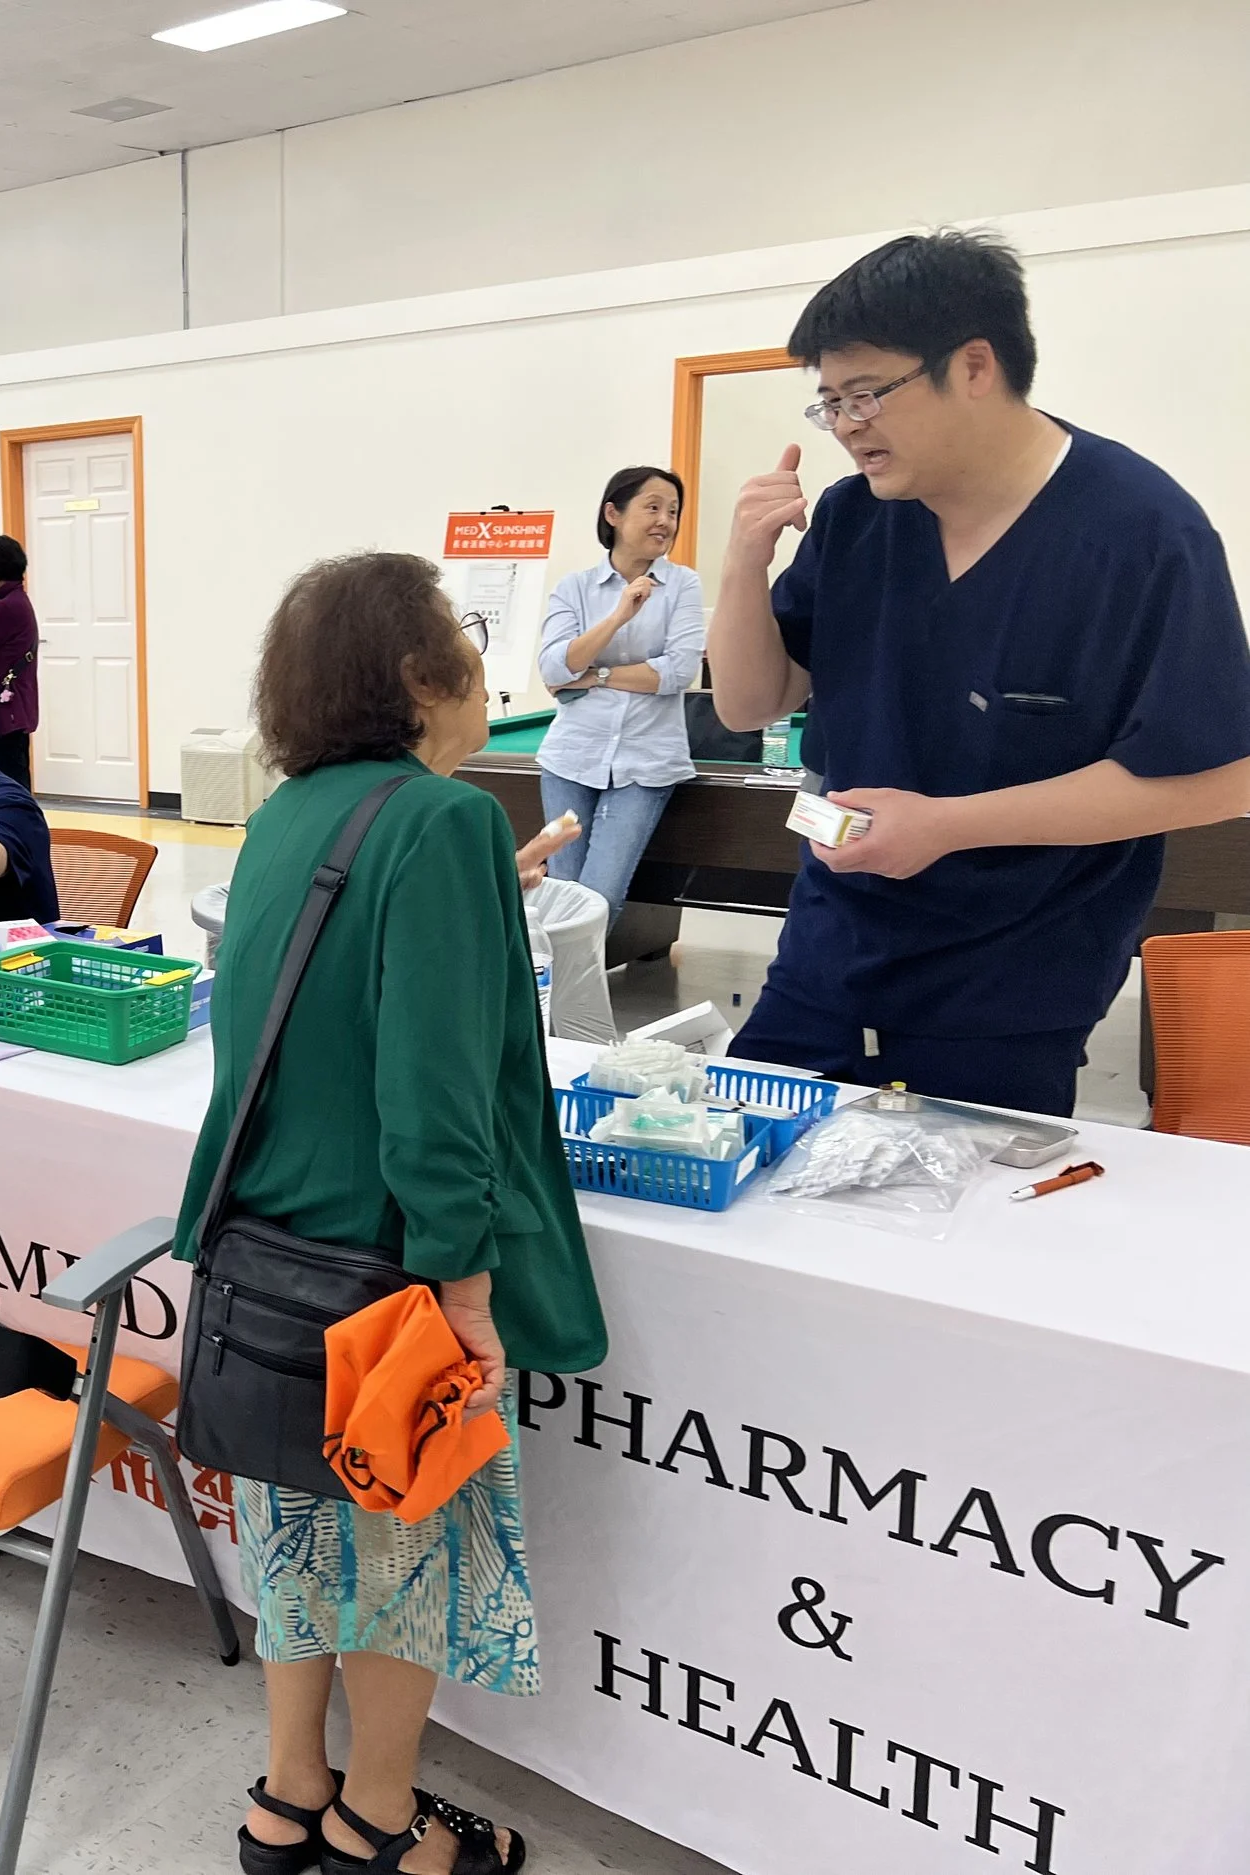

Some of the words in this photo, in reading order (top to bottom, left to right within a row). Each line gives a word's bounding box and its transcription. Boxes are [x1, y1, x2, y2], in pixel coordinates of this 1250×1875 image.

[492, 525, 547, 535] SUNSHINE
[517, 1369, 1225, 1630] PHARMACY
[777, 1576, 853, 1662] &
[593, 1629, 1065, 1875] HEALTH
